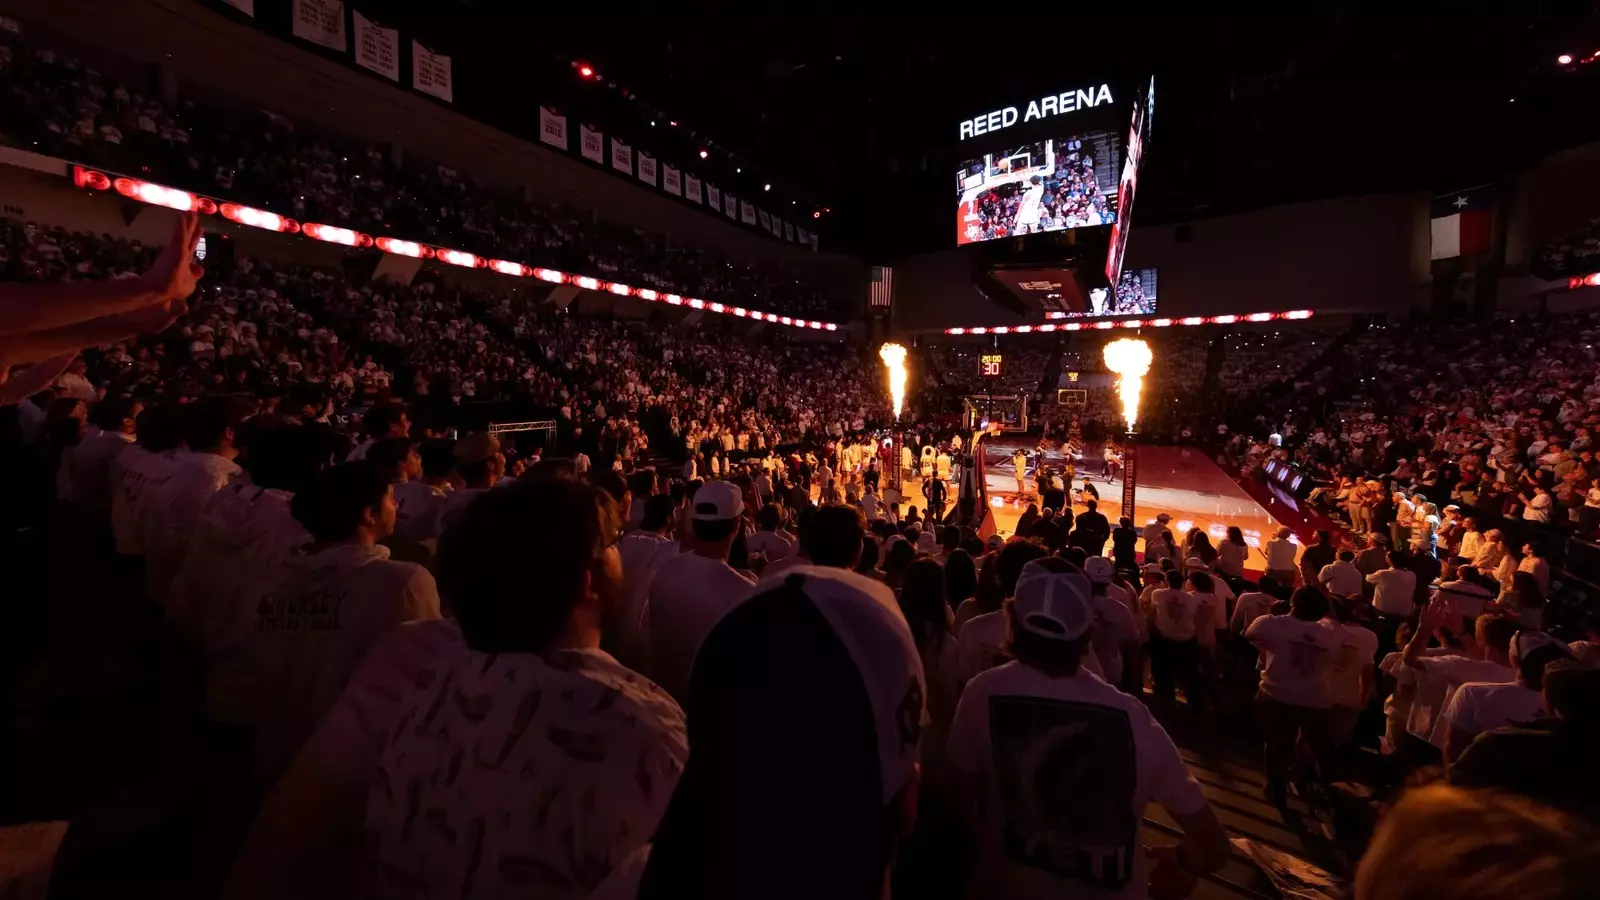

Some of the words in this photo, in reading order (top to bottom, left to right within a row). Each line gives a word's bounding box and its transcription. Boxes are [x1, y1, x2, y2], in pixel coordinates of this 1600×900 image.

[960, 106, 1018, 141] REED
[1023, 83, 1114, 123] ARENA
[981, 355, 1002, 363] 20:00
[984, 363, 1000, 375] 30
[1126, 460, 1134, 477] TEXAS
